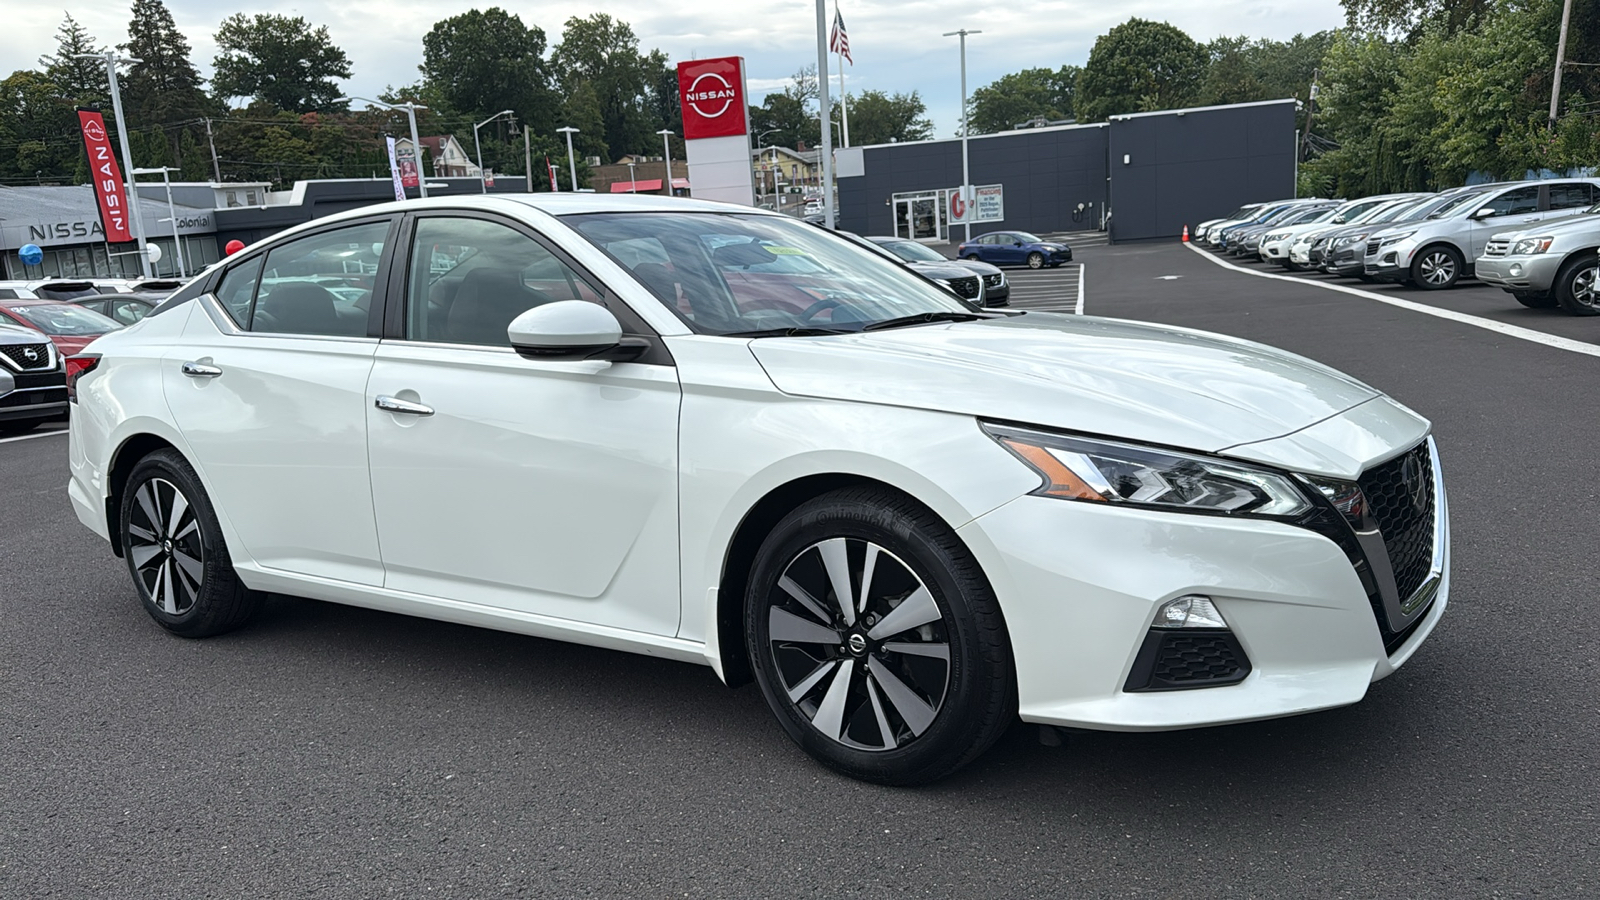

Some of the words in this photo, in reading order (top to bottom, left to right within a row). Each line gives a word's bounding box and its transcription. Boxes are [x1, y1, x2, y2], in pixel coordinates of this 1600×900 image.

[686, 89, 735, 102] NISSAN
[95, 146, 124, 231] NISSAN
[29, 221, 103, 240] NISSA
